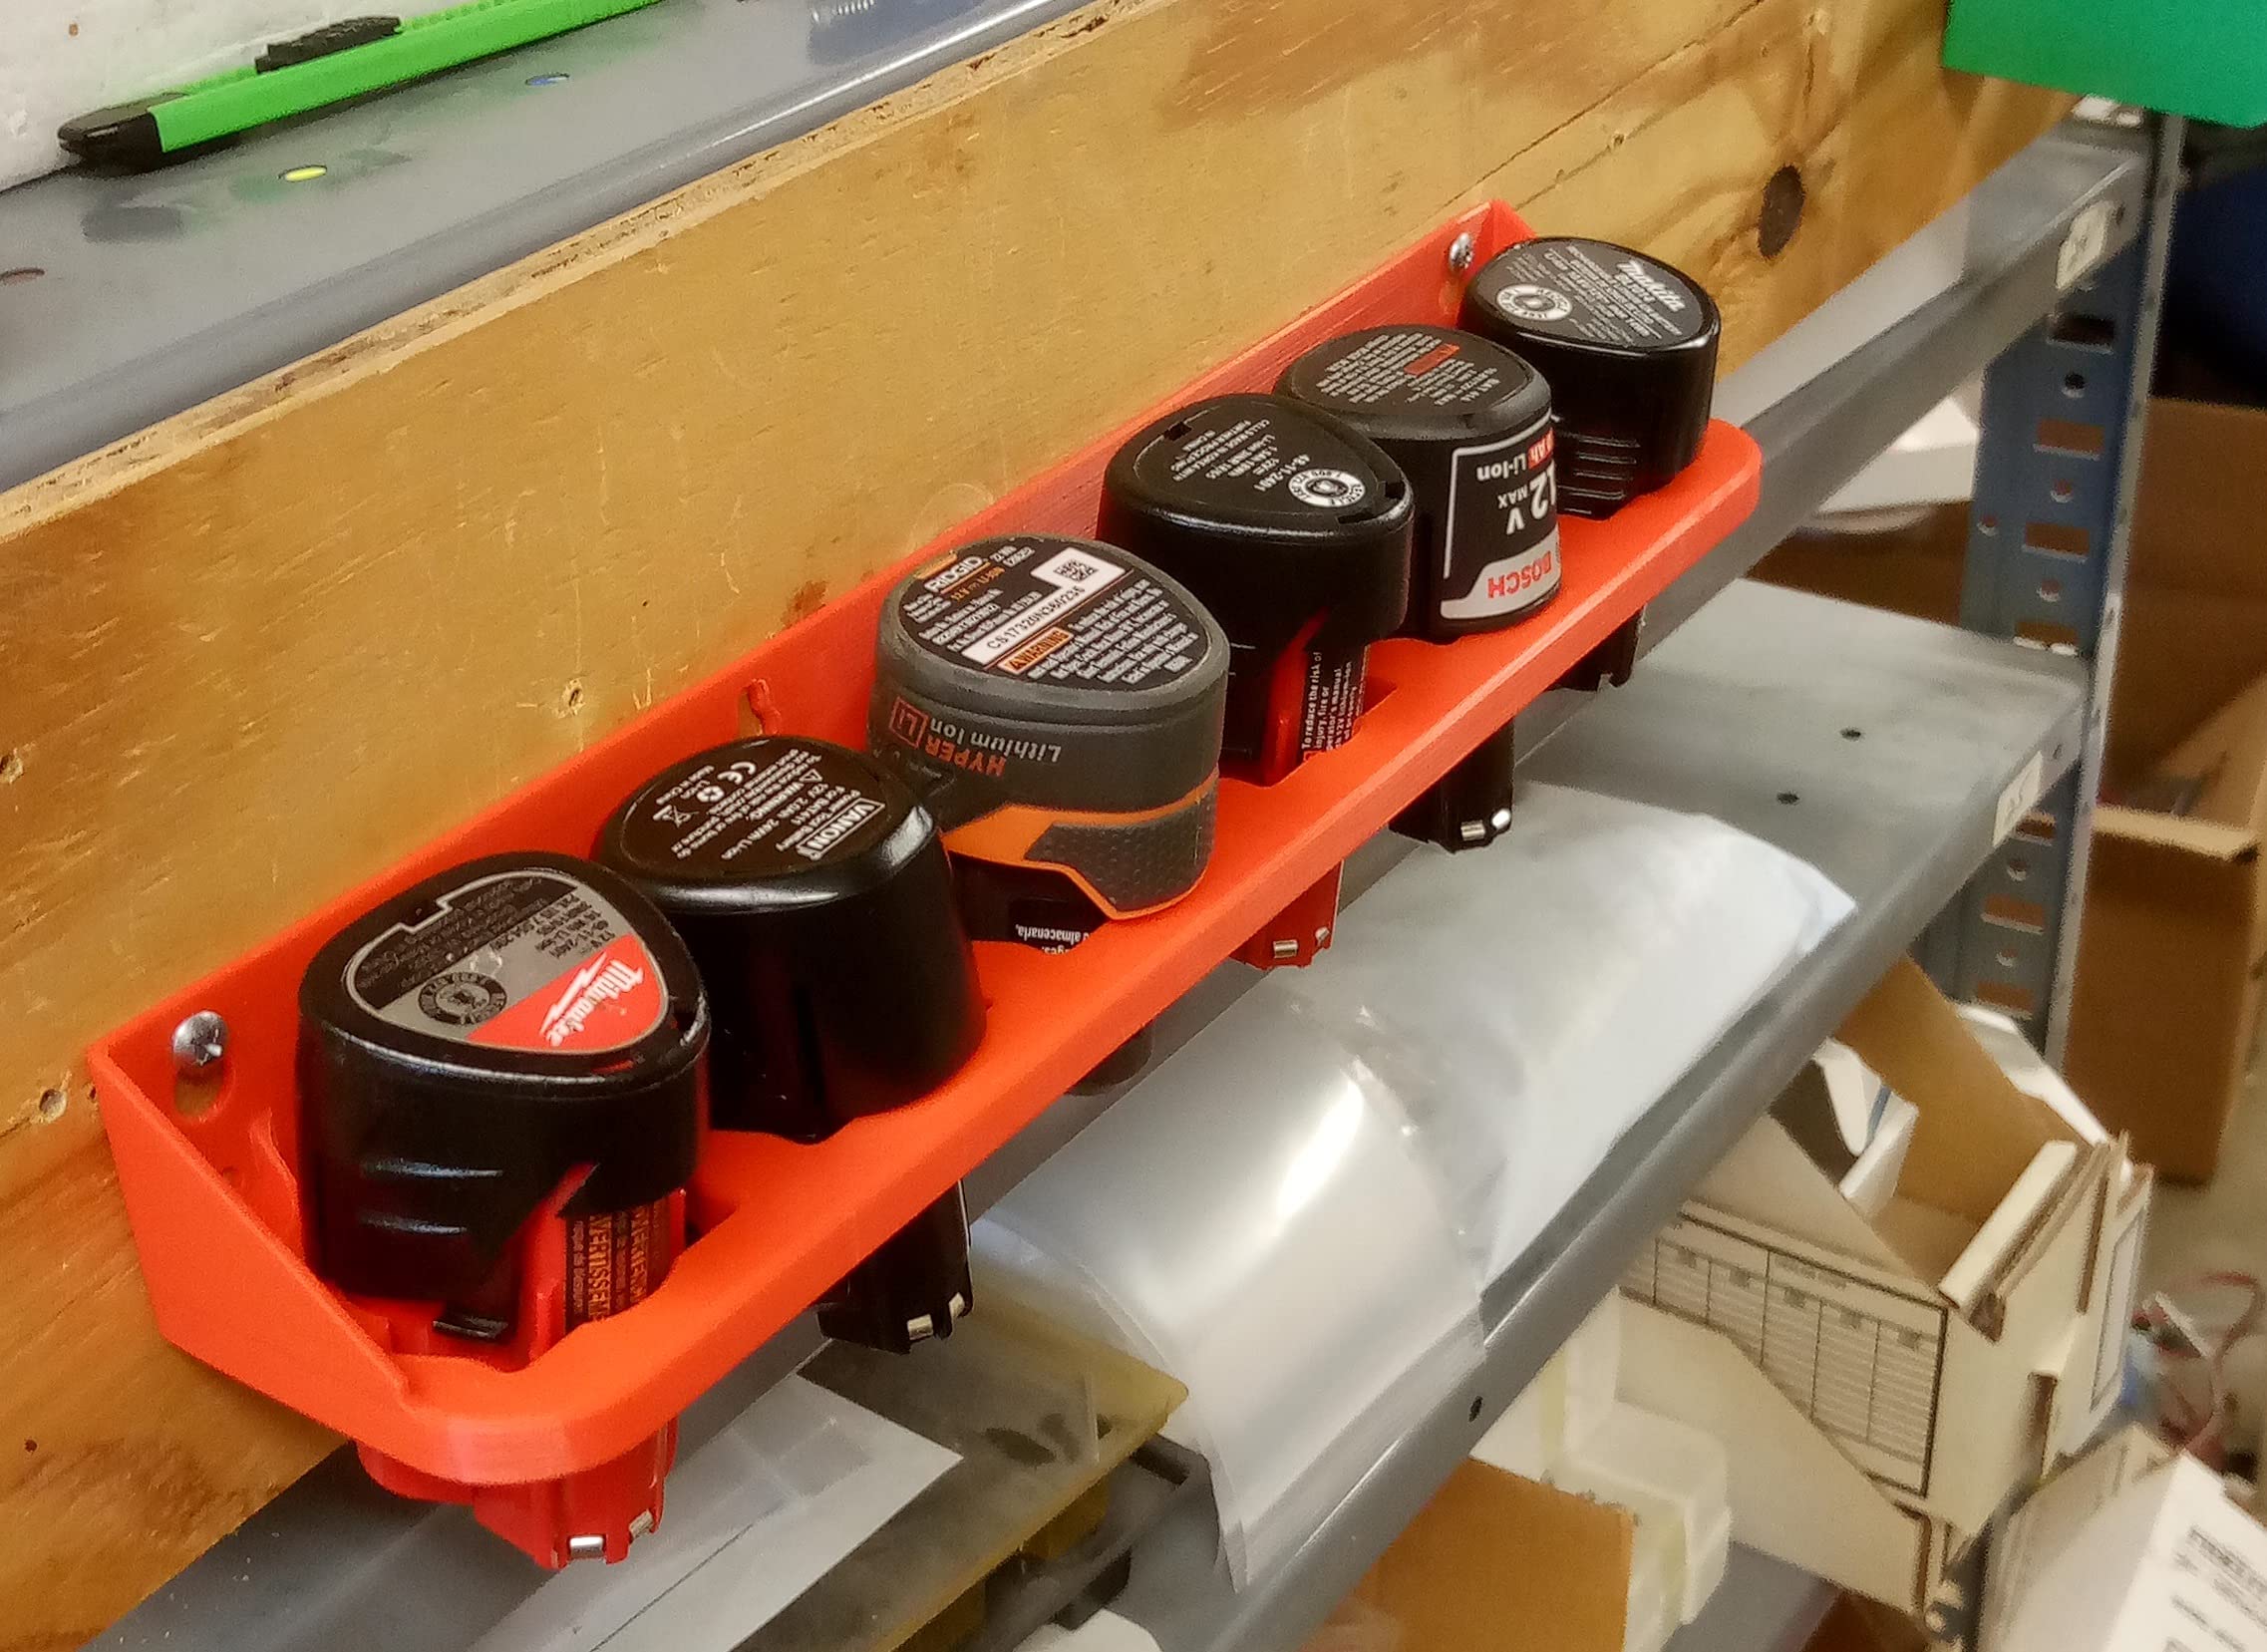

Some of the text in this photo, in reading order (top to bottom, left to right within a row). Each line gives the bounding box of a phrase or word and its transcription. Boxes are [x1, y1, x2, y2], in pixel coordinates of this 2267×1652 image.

[1496, 484, 1526, 508] MAX
[924, 555, 984, 591] RIDGID
[1487, 550, 1551, 597] BOSCH
[930, 717, 1061, 761] Lithium Ion
[1304, 702, 1316, 736] reduce
[925, 735, 1005, 777] HYPER
[804, 803, 875, 850] VANON
[1015, 924, 1081, 944] almacenarla,
[543, 958, 643, 1048] Milwaukee
